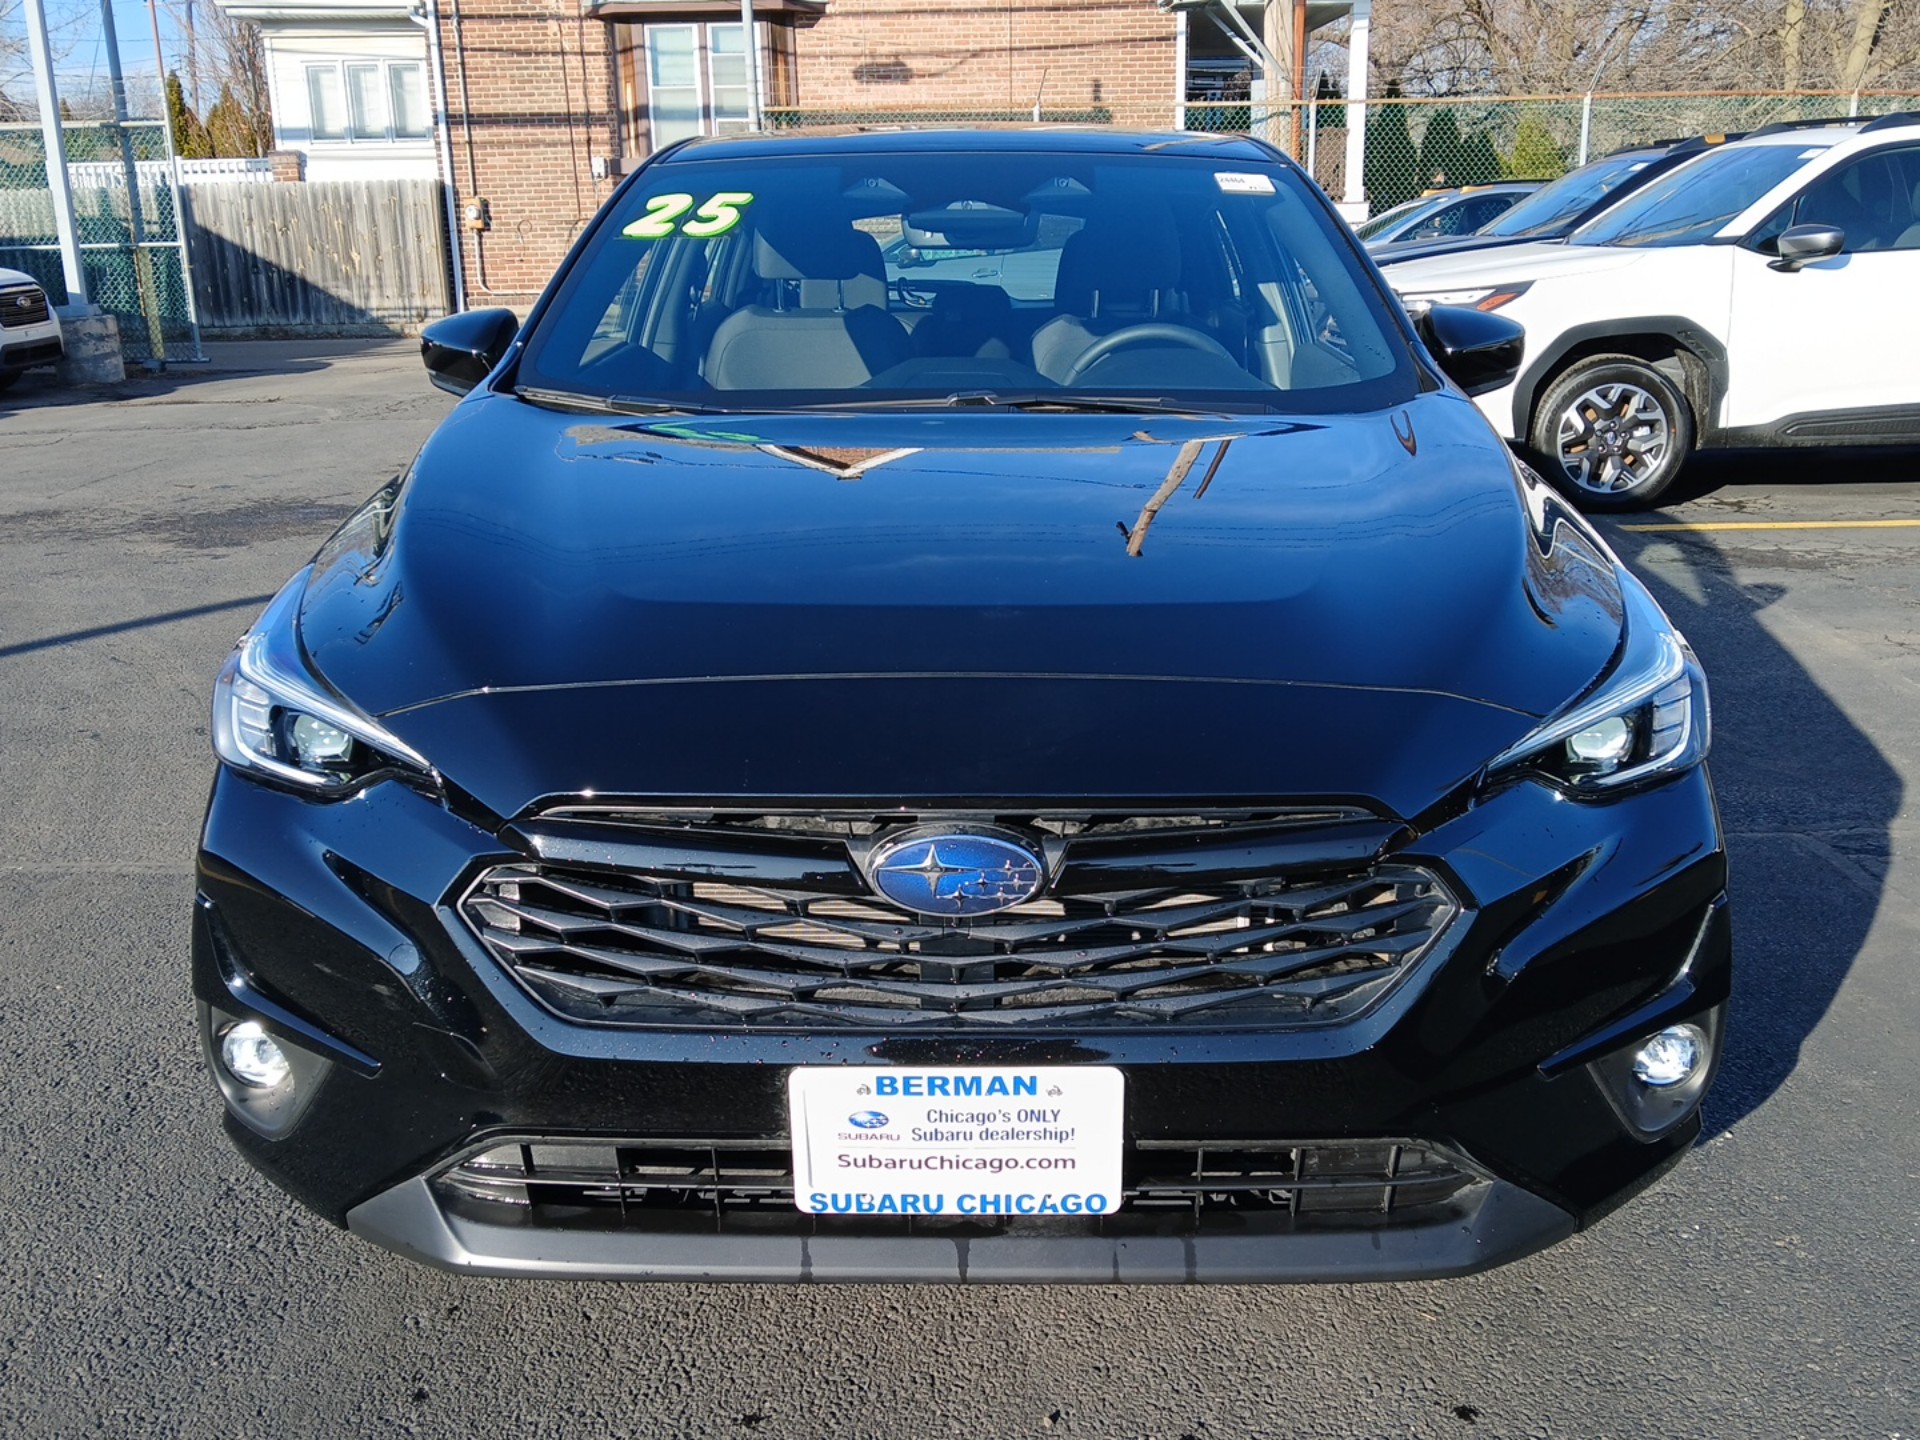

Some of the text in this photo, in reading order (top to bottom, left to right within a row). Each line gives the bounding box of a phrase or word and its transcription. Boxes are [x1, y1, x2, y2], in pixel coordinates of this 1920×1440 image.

[622, 191, 754, 239] 25
[875, 1075, 1037, 1096] BERMAN
[926, 1108, 1061, 1126] Chicago's ONLY
[837, 1132, 901, 1141] SUBARU
[911, 1127, 1076, 1144] Subaru dealership!
[837, 1154, 1076, 1173] SubaruChicago.com
[809, 1192, 1108, 1214] SUBARU CHICAGO
